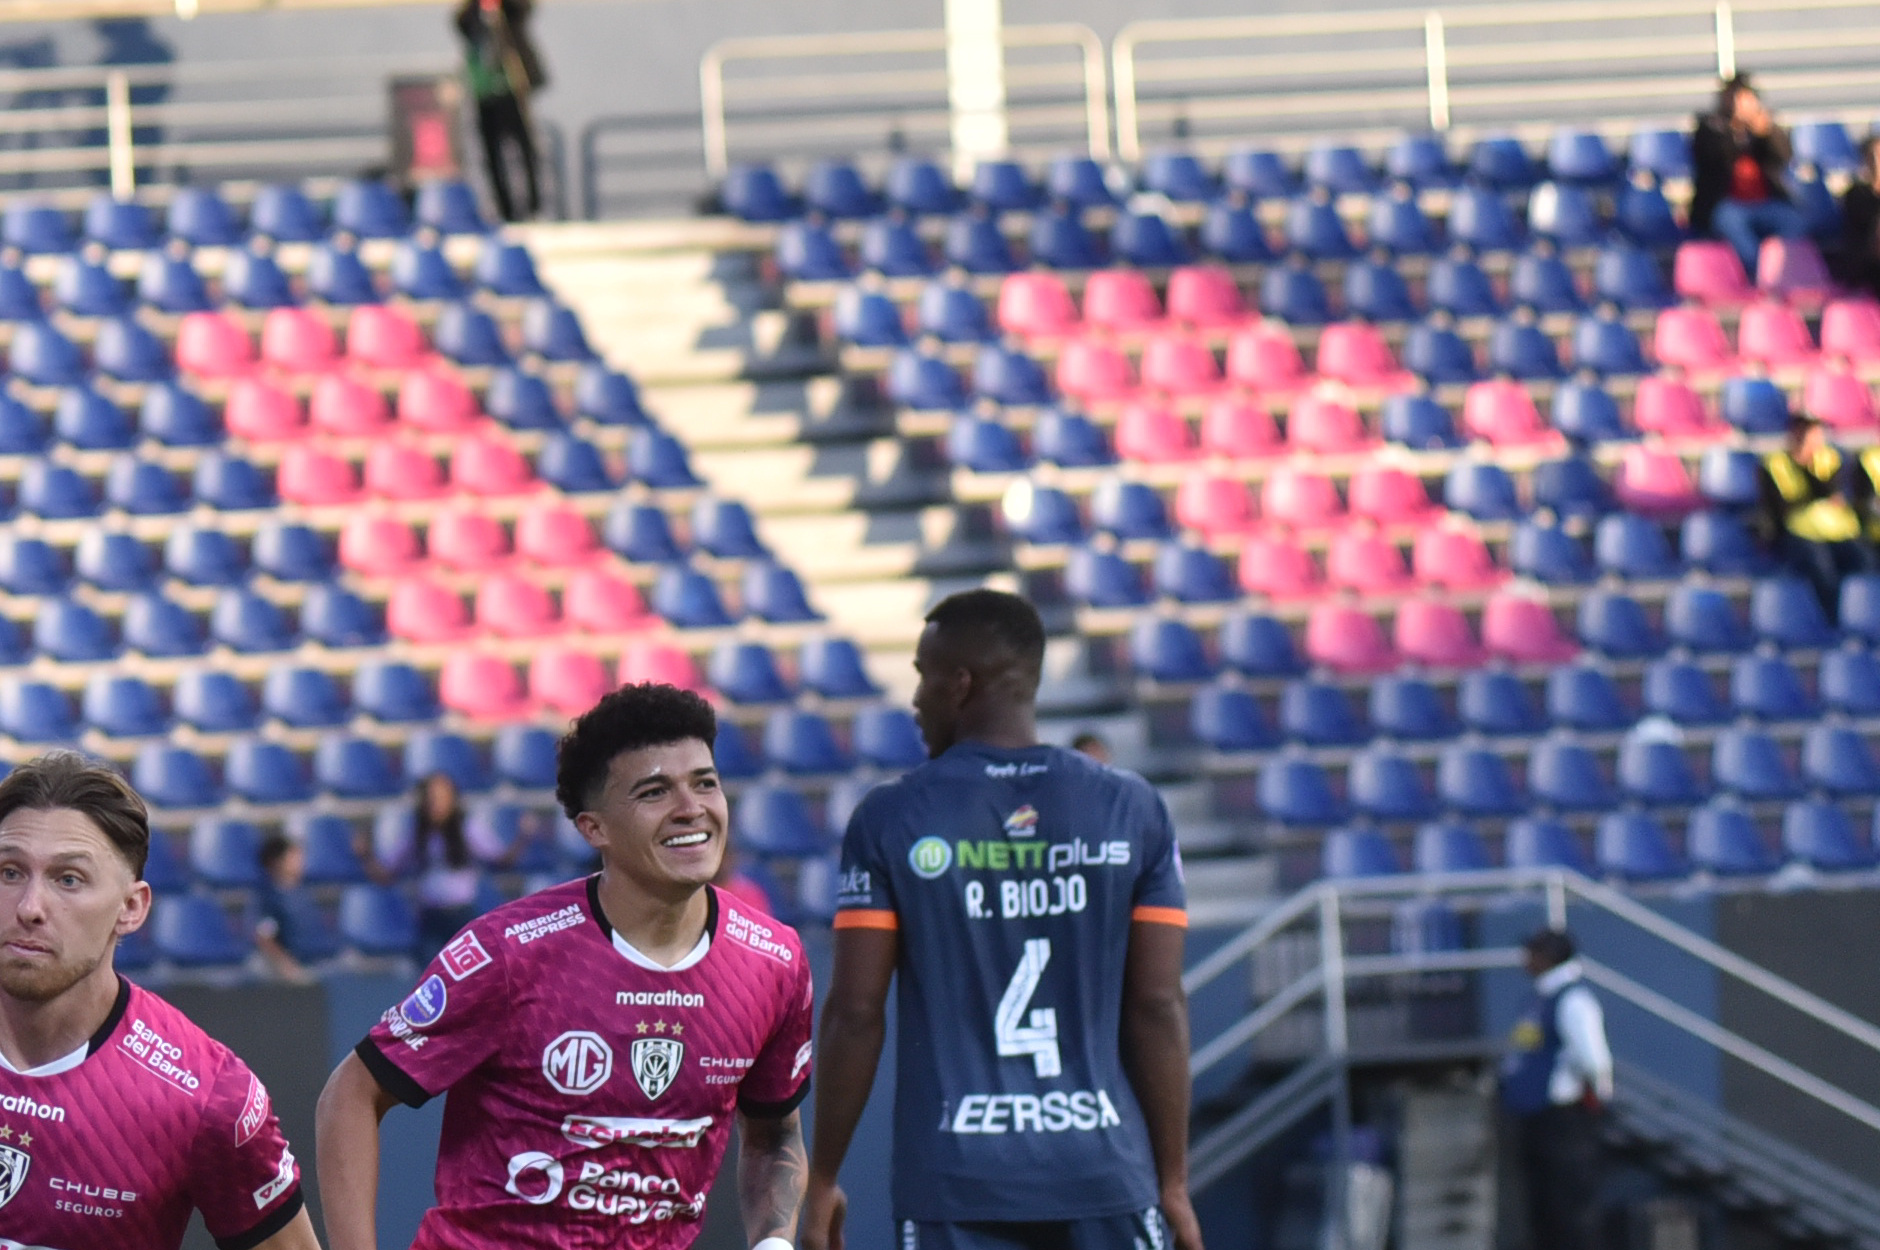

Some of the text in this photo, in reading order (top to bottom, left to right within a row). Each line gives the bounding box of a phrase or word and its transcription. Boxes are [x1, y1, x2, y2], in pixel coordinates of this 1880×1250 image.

[965, 874, 1087, 919] R. BIOJO
[504, 903, 581, 938] AMERICAN
[518, 912, 586, 944] EXPRESS
[728, 908, 773, 938] Banco
[726, 922, 793, 961] del Barrio
[616, 989, 705, 1008] marathon
[994, 938, 1062, 1078] 4
[132, 1018, 183, 1060] Banco
[123, 1033, 200, 1090] del Barrio
[550, 1037, 606, 1090] MG
[705, 1073, 745, 1086] SEGURO
[49, 1177, 137, 1201] CHUBB
[579, 1161, 681, 1194] Banco
[55, 1200, 124, 1218] SEGUROS
